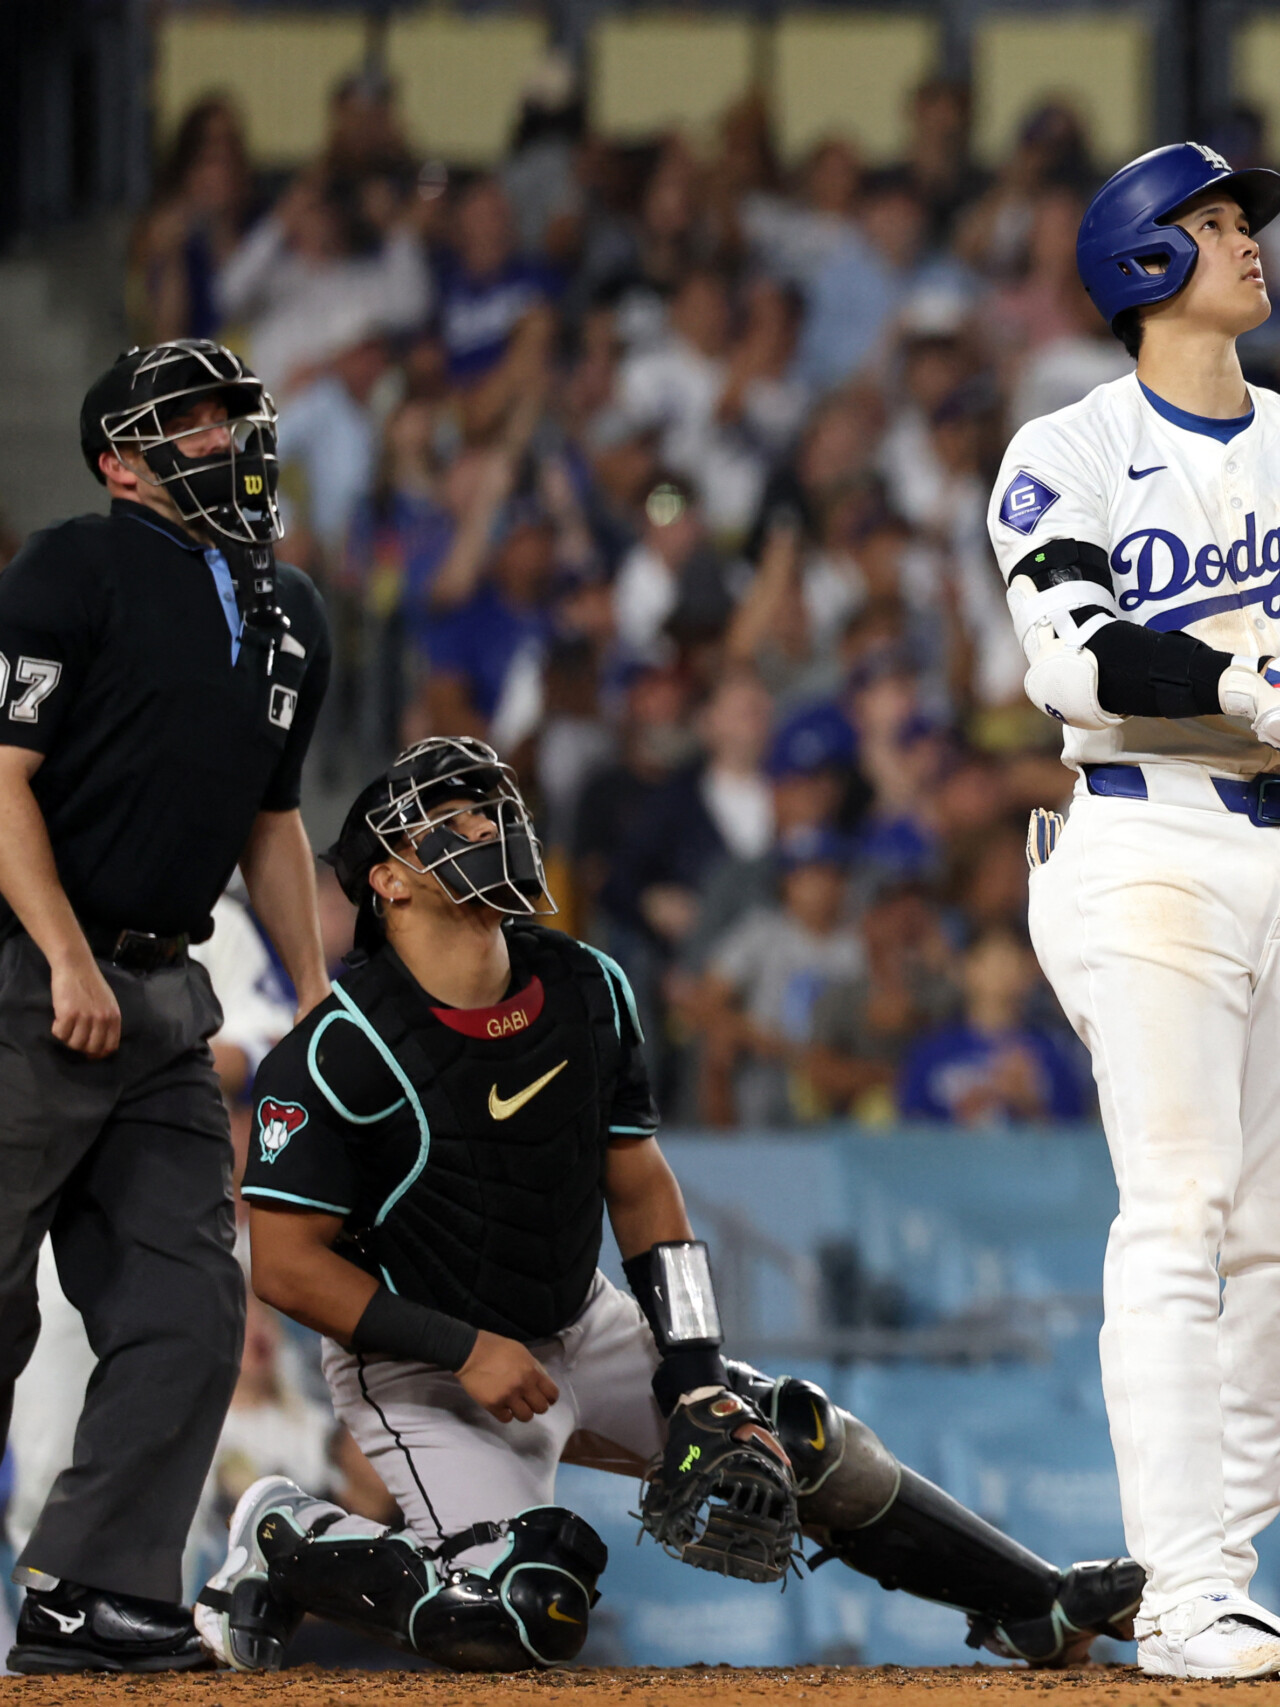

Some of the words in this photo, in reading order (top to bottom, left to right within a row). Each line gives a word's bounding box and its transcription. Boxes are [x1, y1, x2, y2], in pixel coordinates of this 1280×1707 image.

[1010, 484, 1036, 512] G
[0, 651, 62, 723] 7
[486, 1008, 529, 1038] GABI
[262, 1522, 277, 1540] 14
